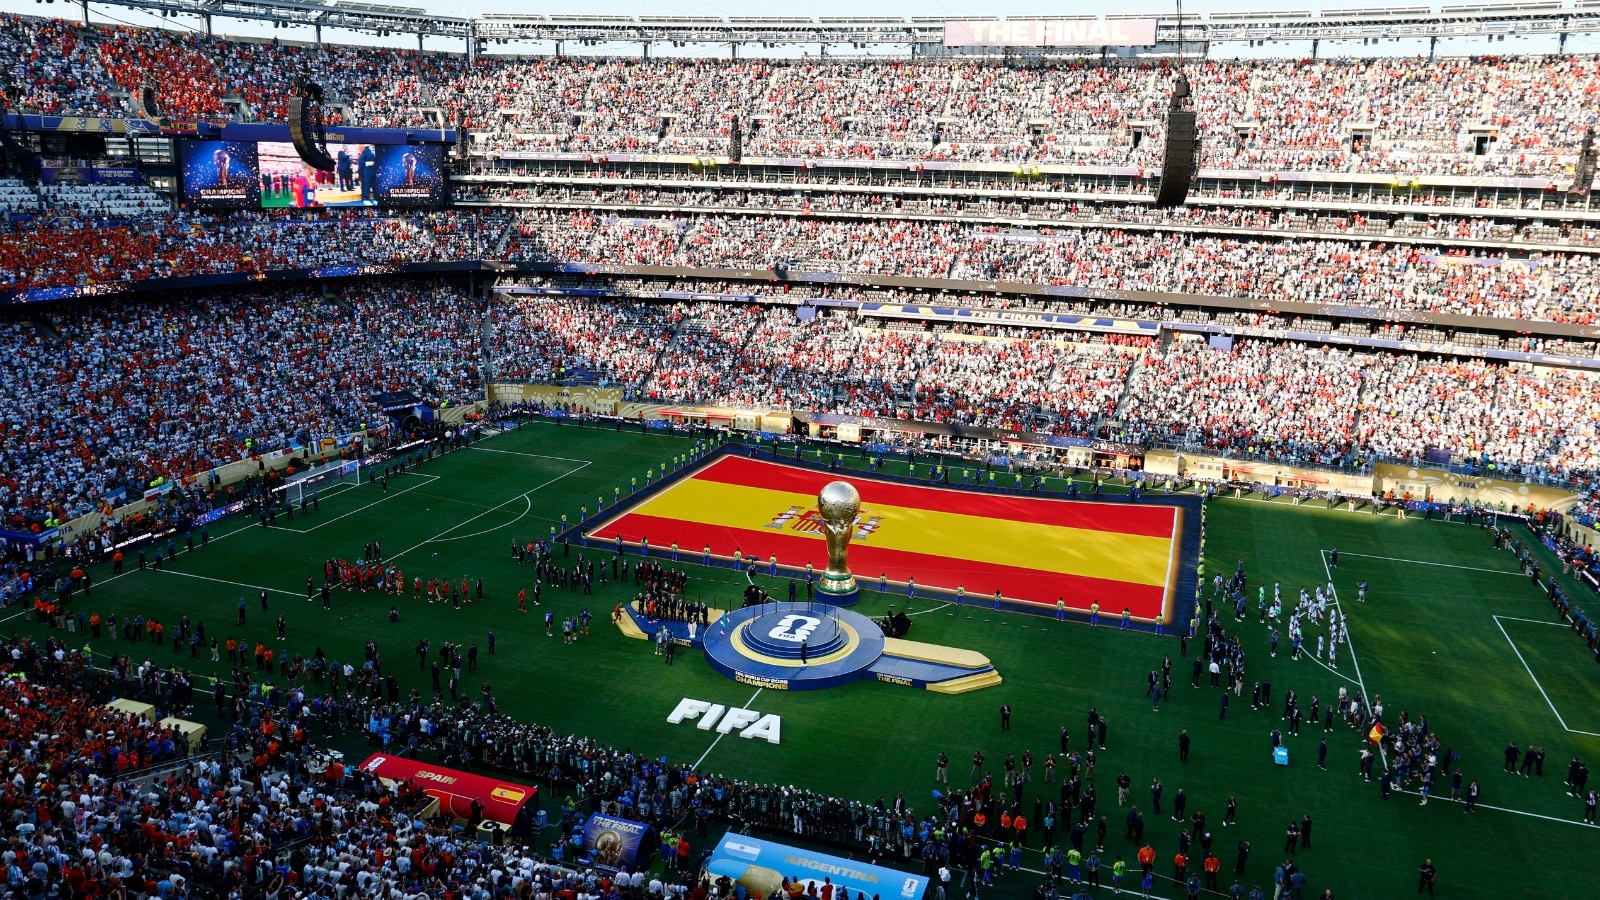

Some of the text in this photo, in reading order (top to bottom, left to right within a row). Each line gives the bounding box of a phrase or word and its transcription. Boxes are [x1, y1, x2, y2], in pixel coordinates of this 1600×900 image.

[969, 21, 1129, 42] THE FINAL
[969, 311, 1046, 322] THE FINAL
[1458, 481, 1478, 490] FIFA
[58, 526, 74, 536] FIFA
[735, 675, 788, 690] CHAMPIONS
[877, 675, 912, 687] THE FINAL
[666, 698, 780, 744] FIFA
[415, 770, 458, 785] SPAIN
[593, 818, 640, 835] THE FINAL
[785, 855, 879, 884] ARGENTINA
